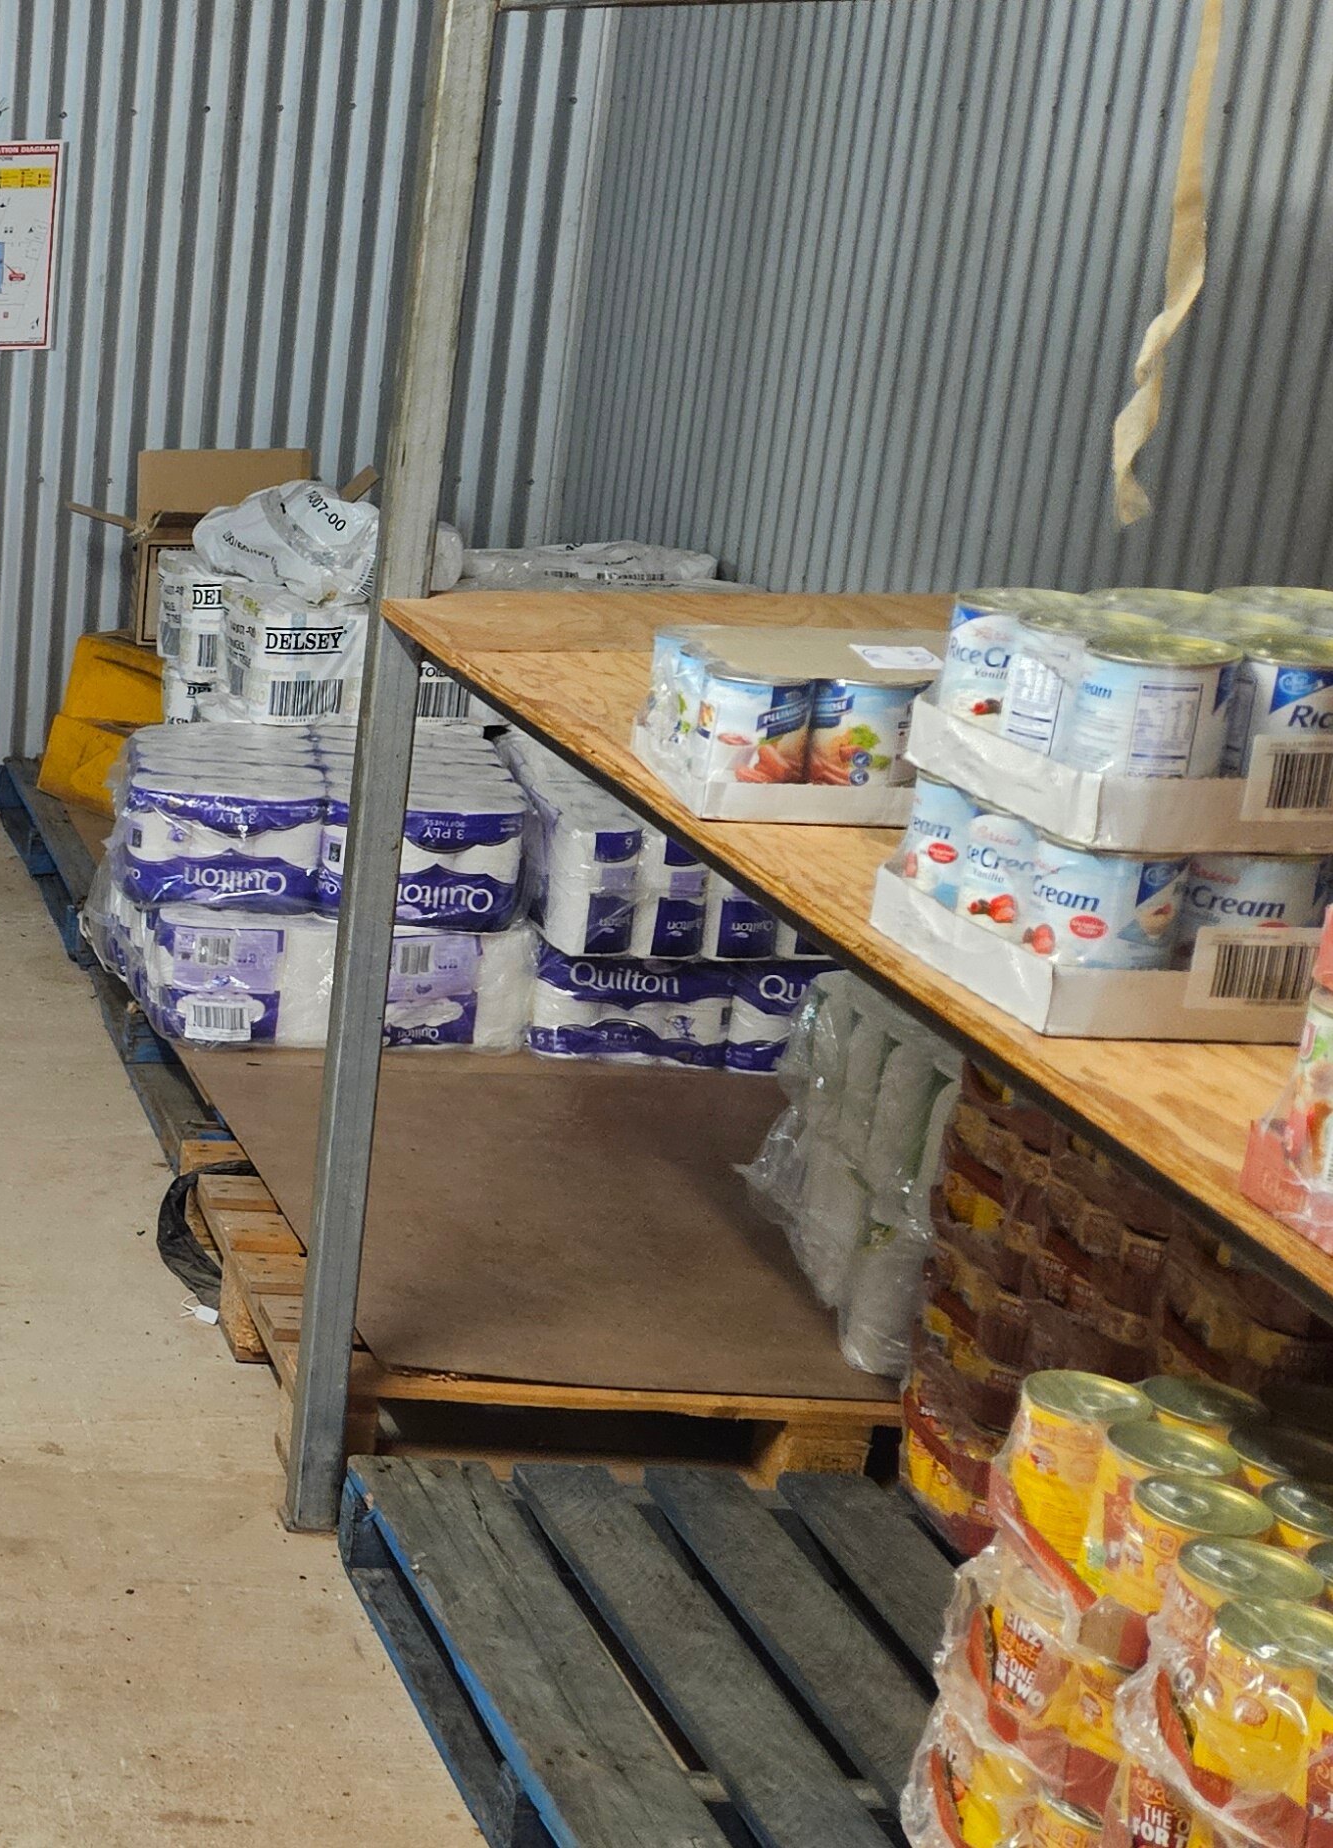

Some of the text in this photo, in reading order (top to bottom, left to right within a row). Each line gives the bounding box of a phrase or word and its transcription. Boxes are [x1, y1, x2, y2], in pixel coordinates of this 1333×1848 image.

[20, 145, 59, 154] DIAGRAM
[265, 632, 343, 650] DELSEY
[216, 811, 258, 825] 3 PLY
[422, 826, 465, 840] 3 PLY
[184, 865, 287, 897] Quilton
[1189, 882, 1286, 920] Cream
[569, 961, 680, 996] Quilton
[1142, 1803, 1172, 1828] THE
[1133, 1817, 1172, 1848] FOR
